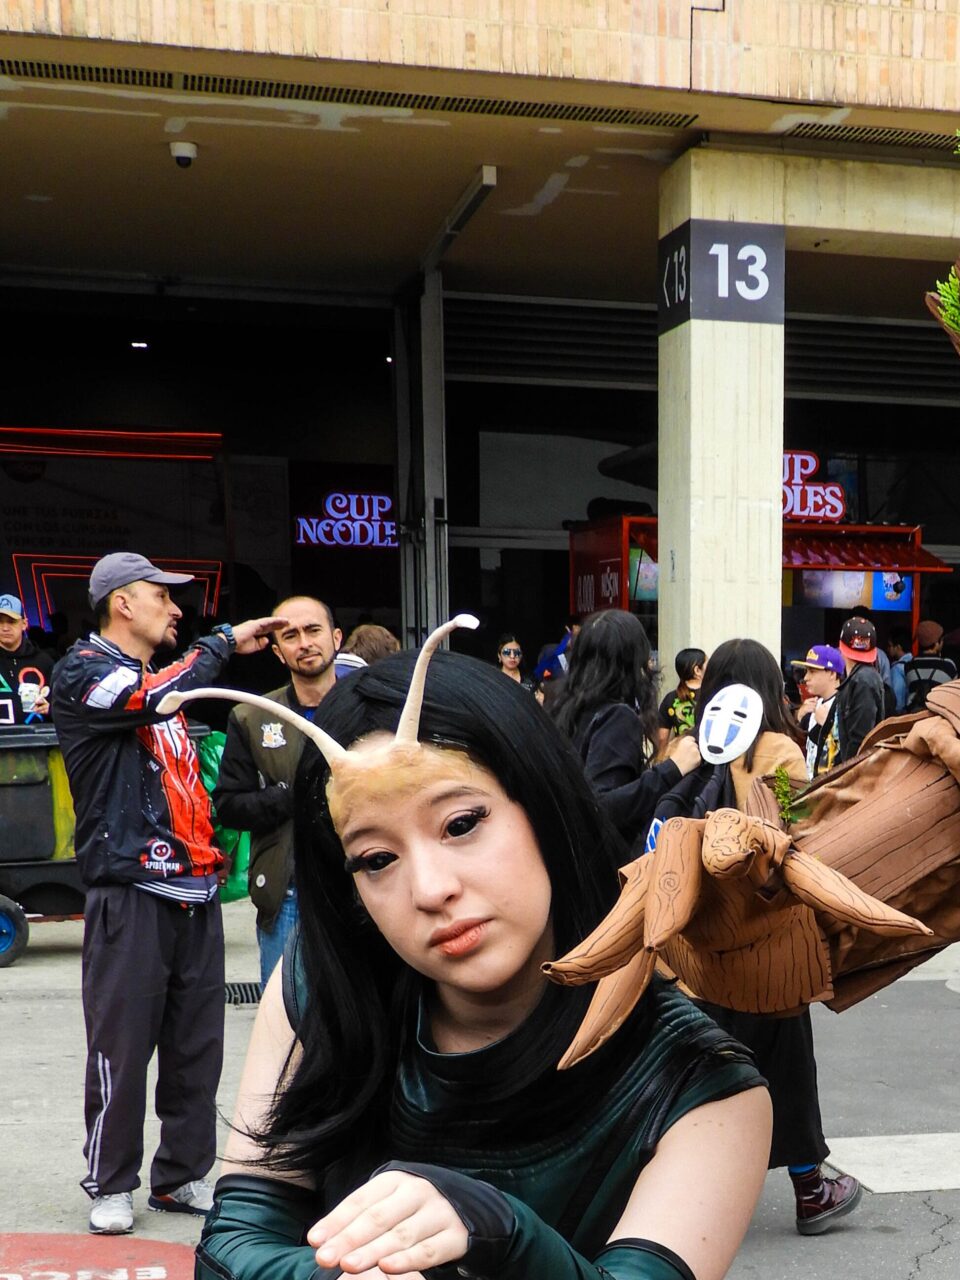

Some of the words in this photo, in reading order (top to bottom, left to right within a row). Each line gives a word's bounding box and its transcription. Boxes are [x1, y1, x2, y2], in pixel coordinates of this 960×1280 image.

[674, 245, 687, 304] 13
[708, 243, 769, 301] 13
[325, 492, 392, 520] CUP
